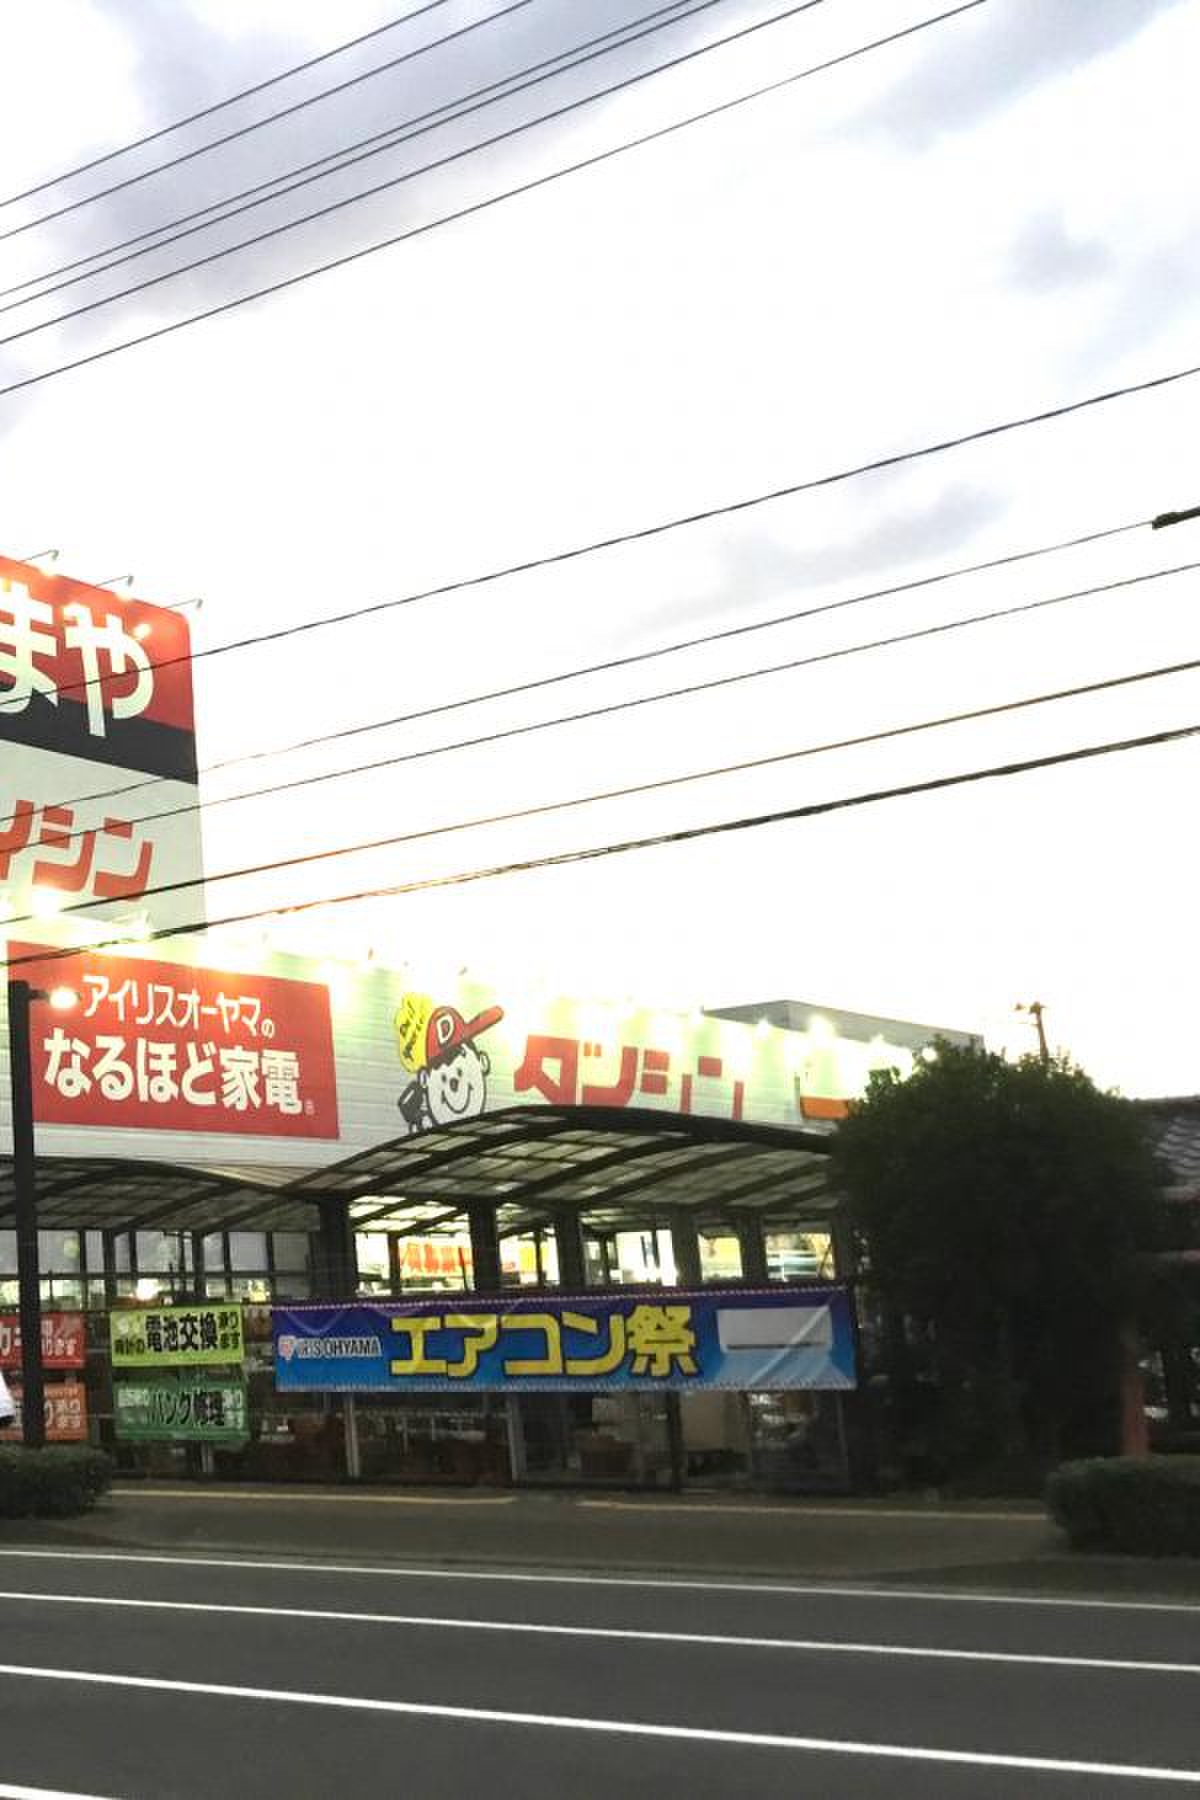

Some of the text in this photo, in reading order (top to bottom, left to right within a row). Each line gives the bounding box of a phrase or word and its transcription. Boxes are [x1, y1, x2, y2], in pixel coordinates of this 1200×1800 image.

[82, 974, 276, 1039] アイリスオーヤマの
[43, 1027, 303, 1116] なるほど家電
[324, 1336, 382, 1358] OHYAMA
[390, 1304, 698, 1378] エアコン祭
